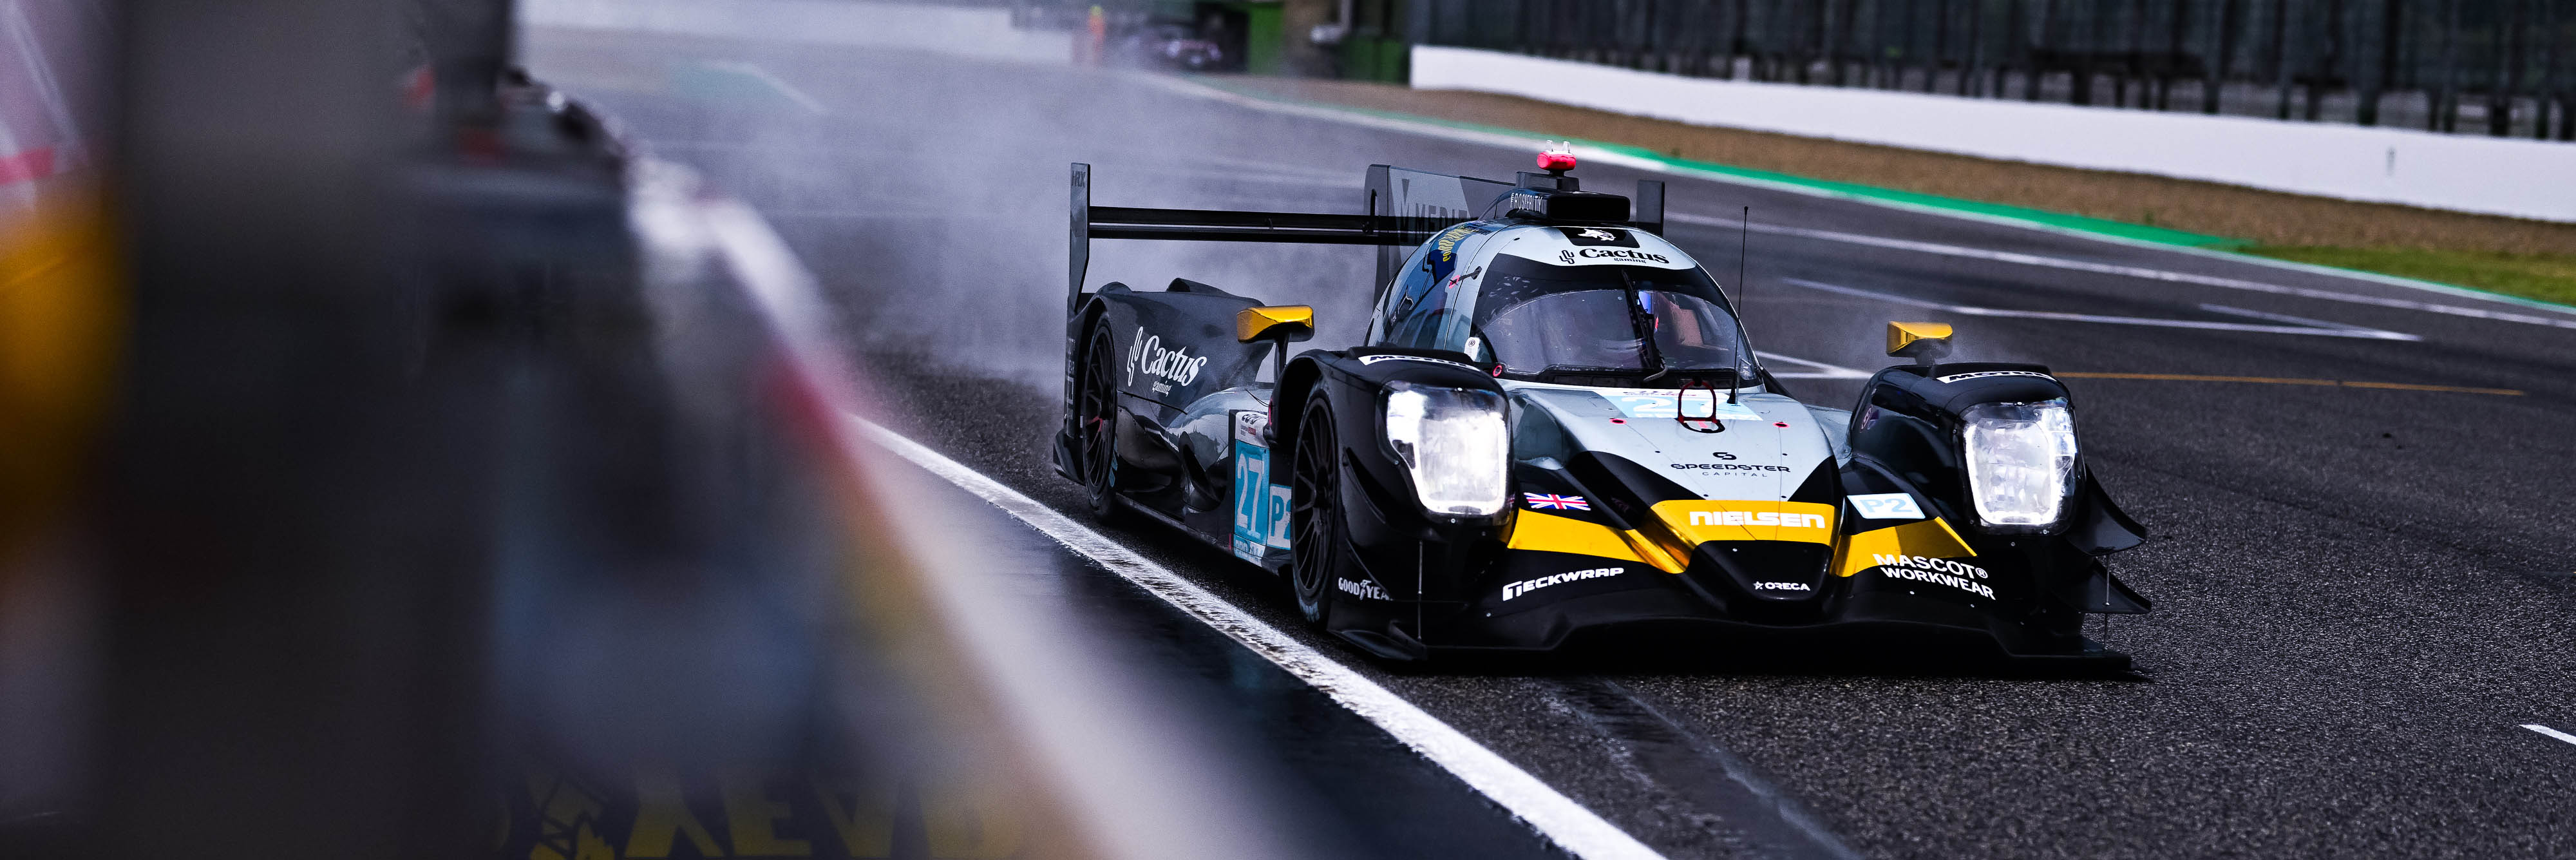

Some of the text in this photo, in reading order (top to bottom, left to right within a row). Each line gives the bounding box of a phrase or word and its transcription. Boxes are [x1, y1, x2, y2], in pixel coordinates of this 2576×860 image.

[1579, 249, 1670, 263] Cactus
[1141, 335, 1207, 387] Cactus
[1152, 380, 1173, 397] gaming
[1671, 463, 1791, 472] SPEEDSTER
[1237, 453, 1265, 533] 27
[1859, 498, 1913, 513] P2
[1689, 511, 1826, 528] NIELSEN
[1502, 568, 1624, 601] TECKWRAP
[1765, 582, 1810, 591] ORECA
[1880, 567, 1996, 600] WORKWEAR
